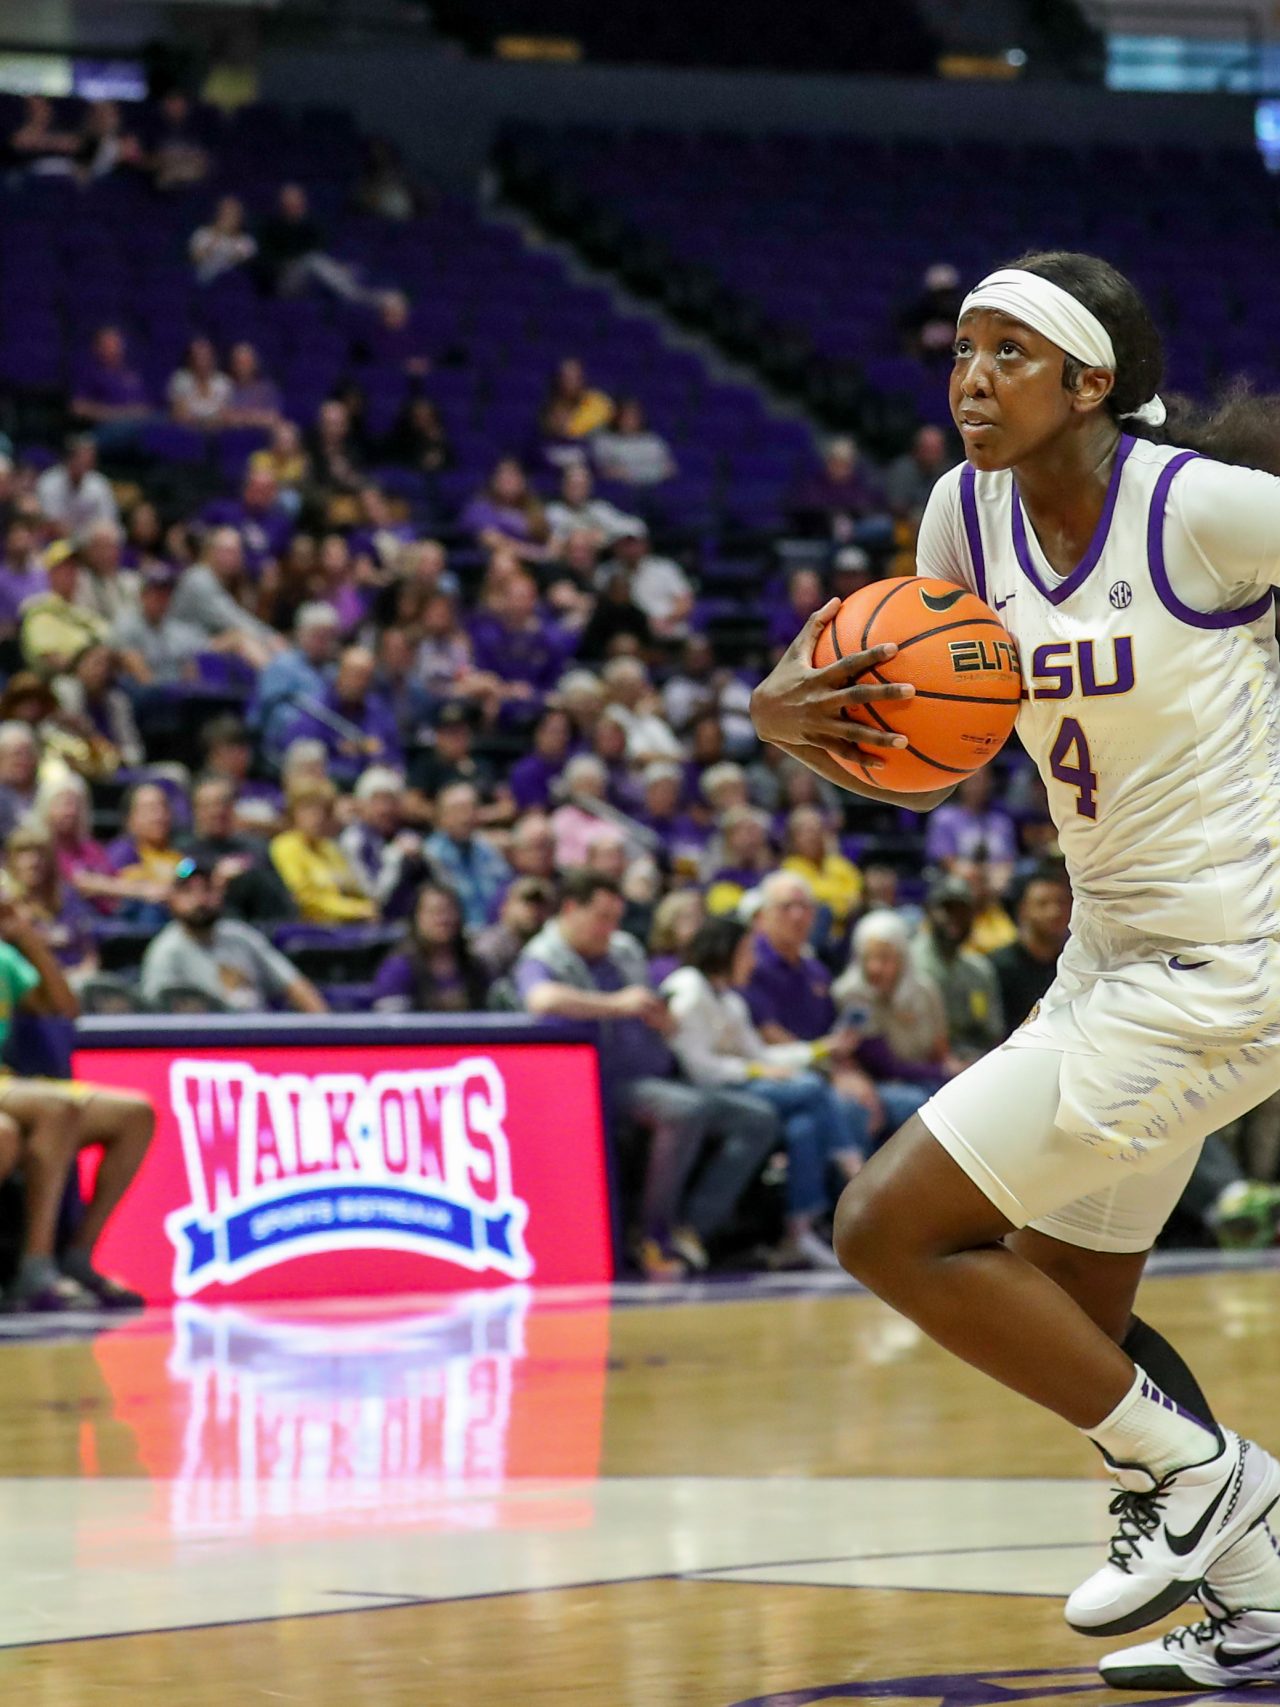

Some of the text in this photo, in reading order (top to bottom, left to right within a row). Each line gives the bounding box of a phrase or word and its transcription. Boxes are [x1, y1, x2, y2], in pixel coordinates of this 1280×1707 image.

[1109, 581, 1132, 608] SEC
[1021, 635, 1136, 701] SU
[1049, 715, 1098, 820] 4
